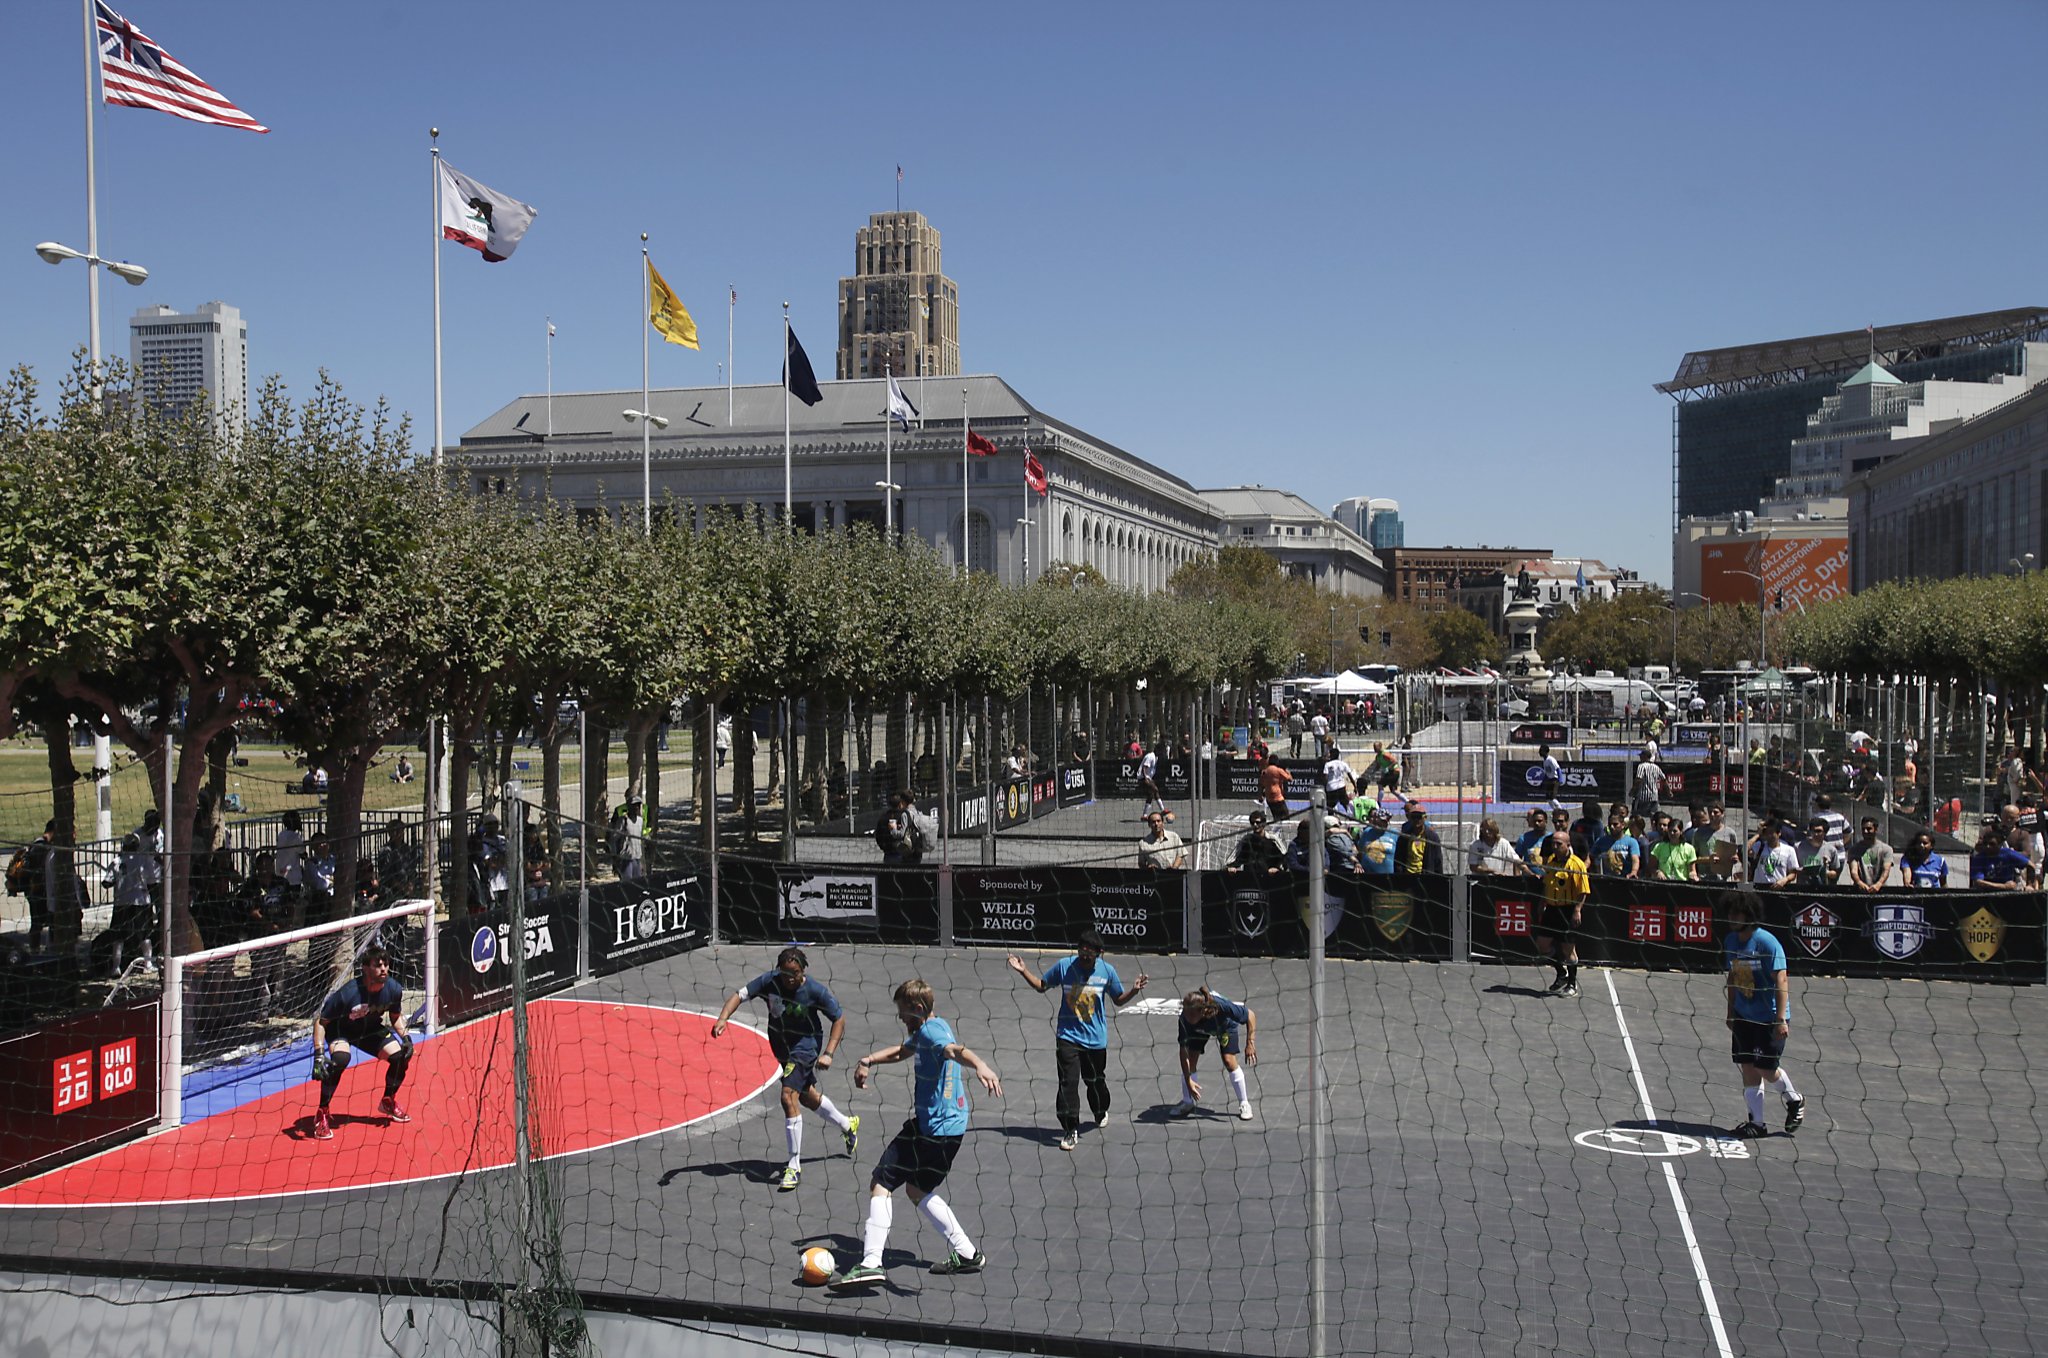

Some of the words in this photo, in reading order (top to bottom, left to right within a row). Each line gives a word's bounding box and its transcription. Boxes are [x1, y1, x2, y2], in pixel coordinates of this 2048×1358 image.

[1760, 540, 1798, 571] DAZZLES
[1765, 537, 1823, 582] TRANSFORMS
[1815, 546, 1848, 580] DRA
[1765, 563, 1807, 597] THROUGH
[1813, 580, 1847, 602] OY,
[1072, 774, 1086, 788] USA
[961, 801, 964, 830] I
[964, 798, 979, 830] PLAY
[979, 796, 988, 825] FO
[980, 879, 1029, 891] Sponsored
[1031, 881, 1043, 892] by
[1090, 883, 1141, 895] Sponsored
[1143, 886, 1155, 896] by
[981, 902, 1035, 916] WELLS
[1092, 907, 1148, 921] WELLS
[523, 914, 550, 930] Soccer
[613, 890, 688, 946] HOPE
[982, 917, 1035, 931] FARGO
[1678, 911, 1705, 924] UNI
[1094, 922, 1147, 936] FARGO
[1678, 925, 1708, 940] QLO
[1801, 926, 1831, 938] CHANGE
[1969, 930, 1997, 944] HOPE
[105, 1045, 131, 1069] UNI
[105, 1066, 133, 1093] QLO
